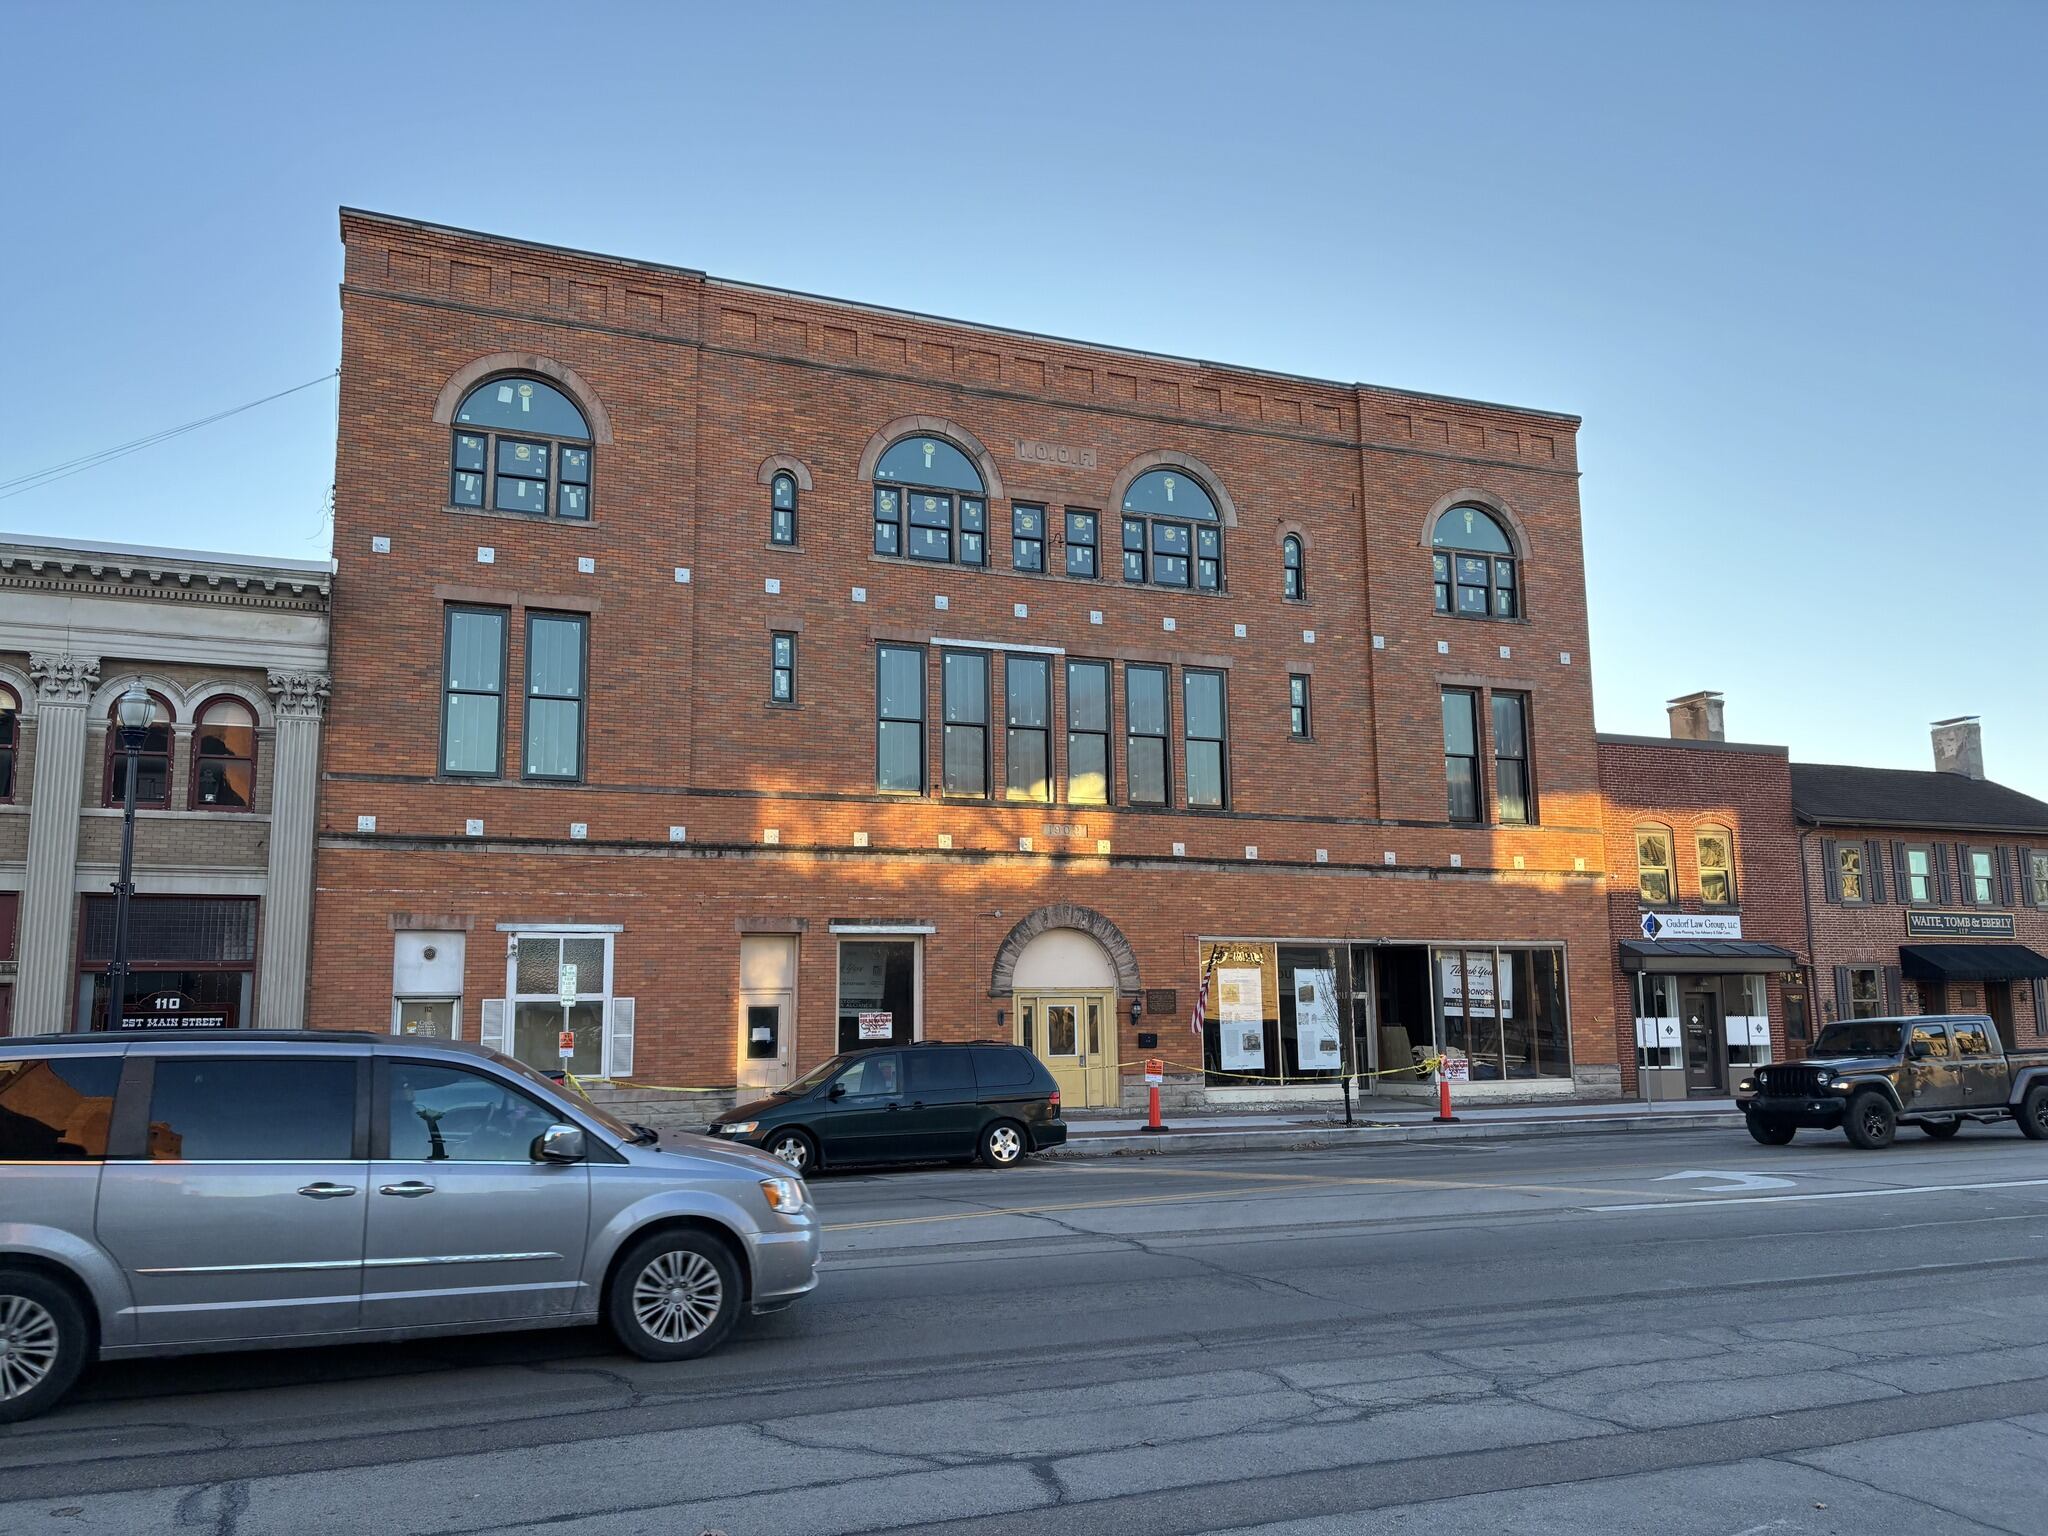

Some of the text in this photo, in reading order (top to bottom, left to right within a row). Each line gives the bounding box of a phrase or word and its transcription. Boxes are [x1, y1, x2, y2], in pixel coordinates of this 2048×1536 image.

[1665, 918, 1690, 928] Gudorf
[1690, 919, 1703, 928] Law
[1704, 919, 1727, 930] Group,
[1910, 915, 2012, 929] WAITE, TOMB & EBERLY
[154, 997, 180, 1010] 110
[121, 1017, 223, 1028] EST MAIN STREET
